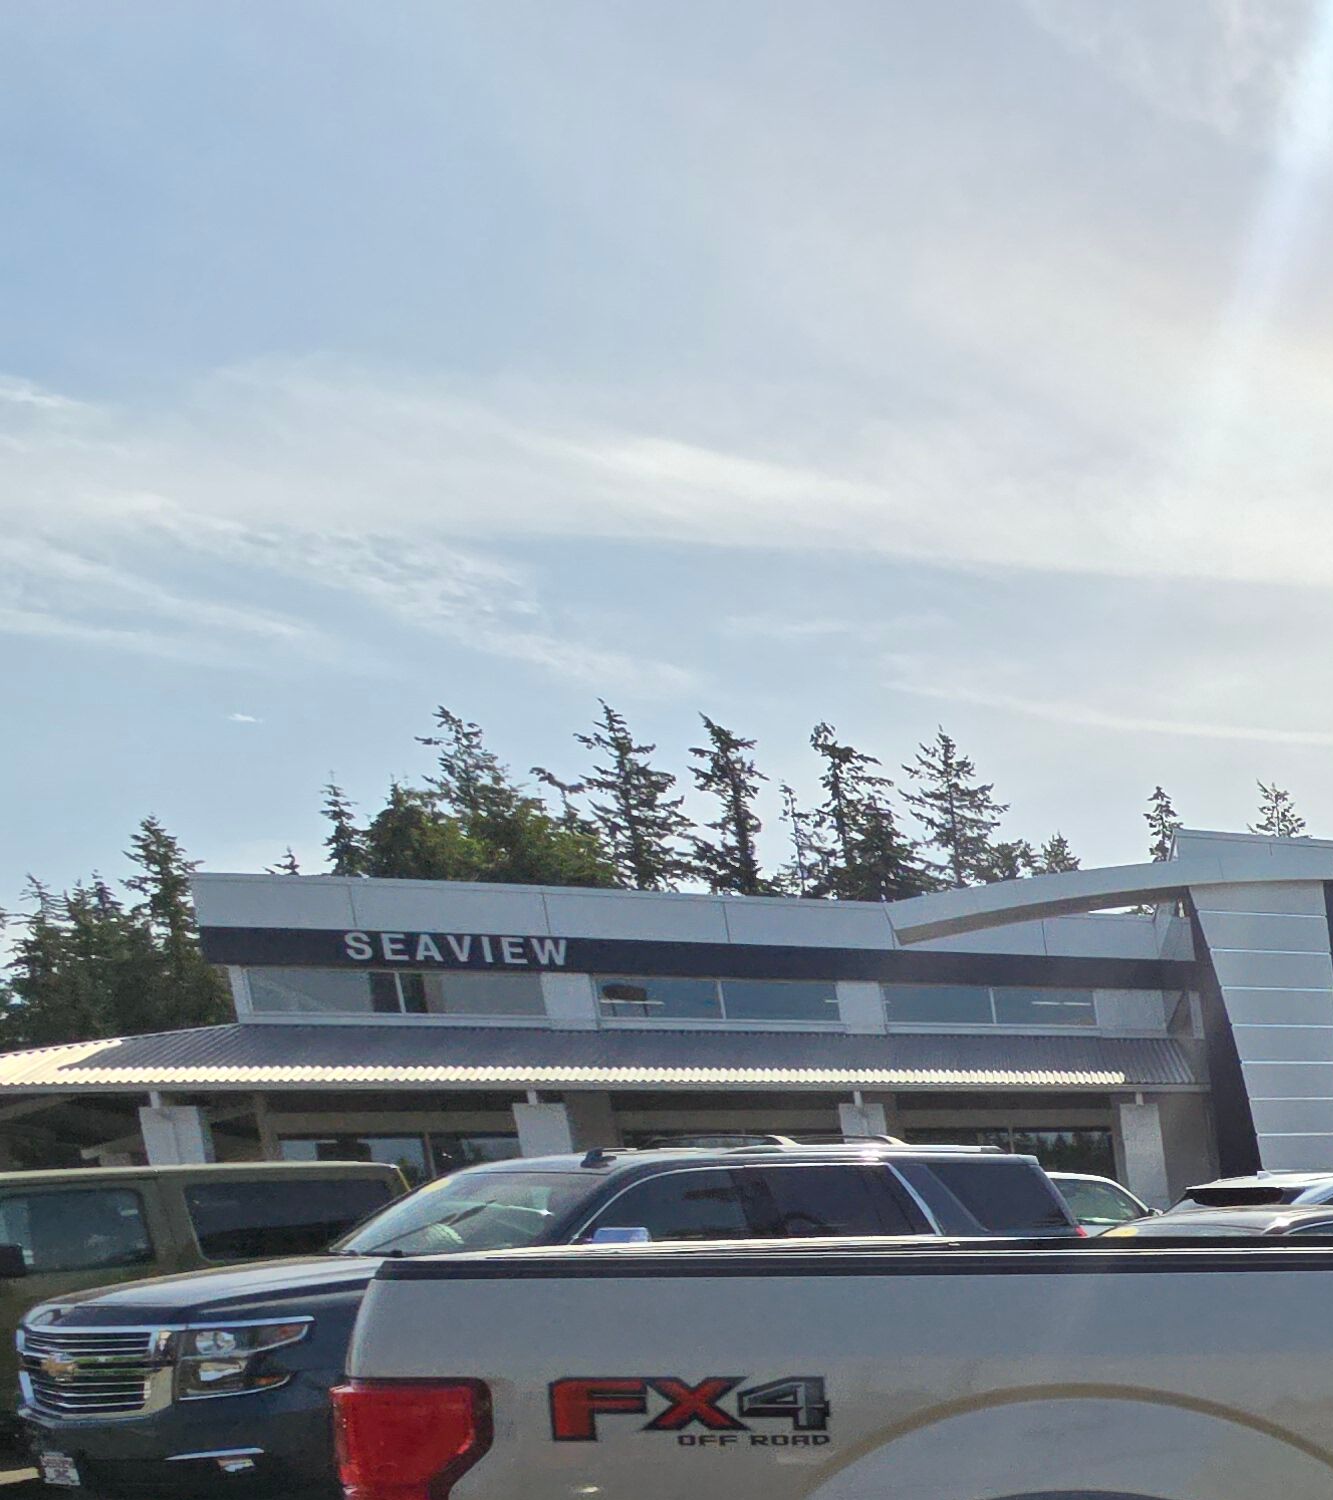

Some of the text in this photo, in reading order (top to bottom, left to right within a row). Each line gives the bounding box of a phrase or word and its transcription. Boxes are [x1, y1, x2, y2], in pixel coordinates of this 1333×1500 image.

[344, 931, 567, 966] SEAVIEW
[549, 1376, 830, 1441] FX4
[677, 1434, 831, 1447] OFF ROAD
